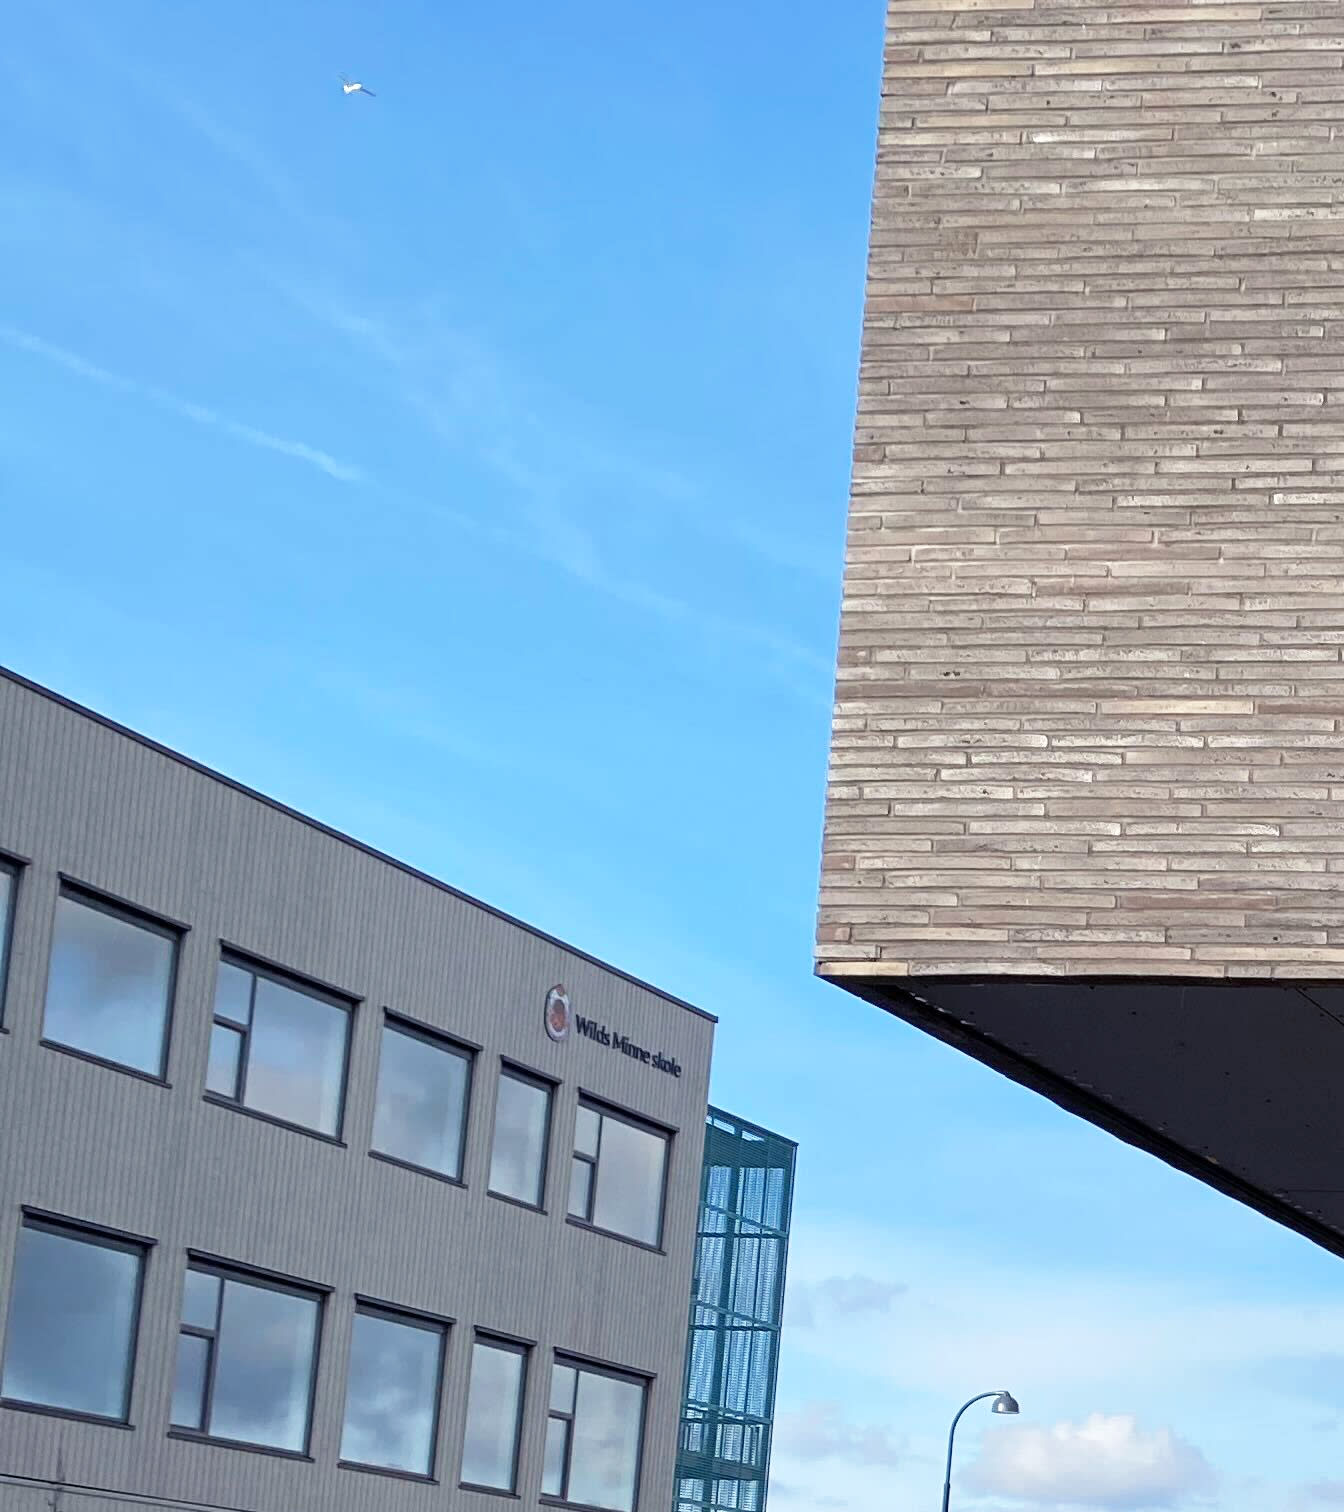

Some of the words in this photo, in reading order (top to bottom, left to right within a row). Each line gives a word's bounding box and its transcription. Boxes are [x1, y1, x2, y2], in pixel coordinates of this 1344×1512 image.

[576, 1014, 610, 1046] Wilds
[612, 1032, 650, 1064] Minne
[652, 1051, 681, 1078] skole
